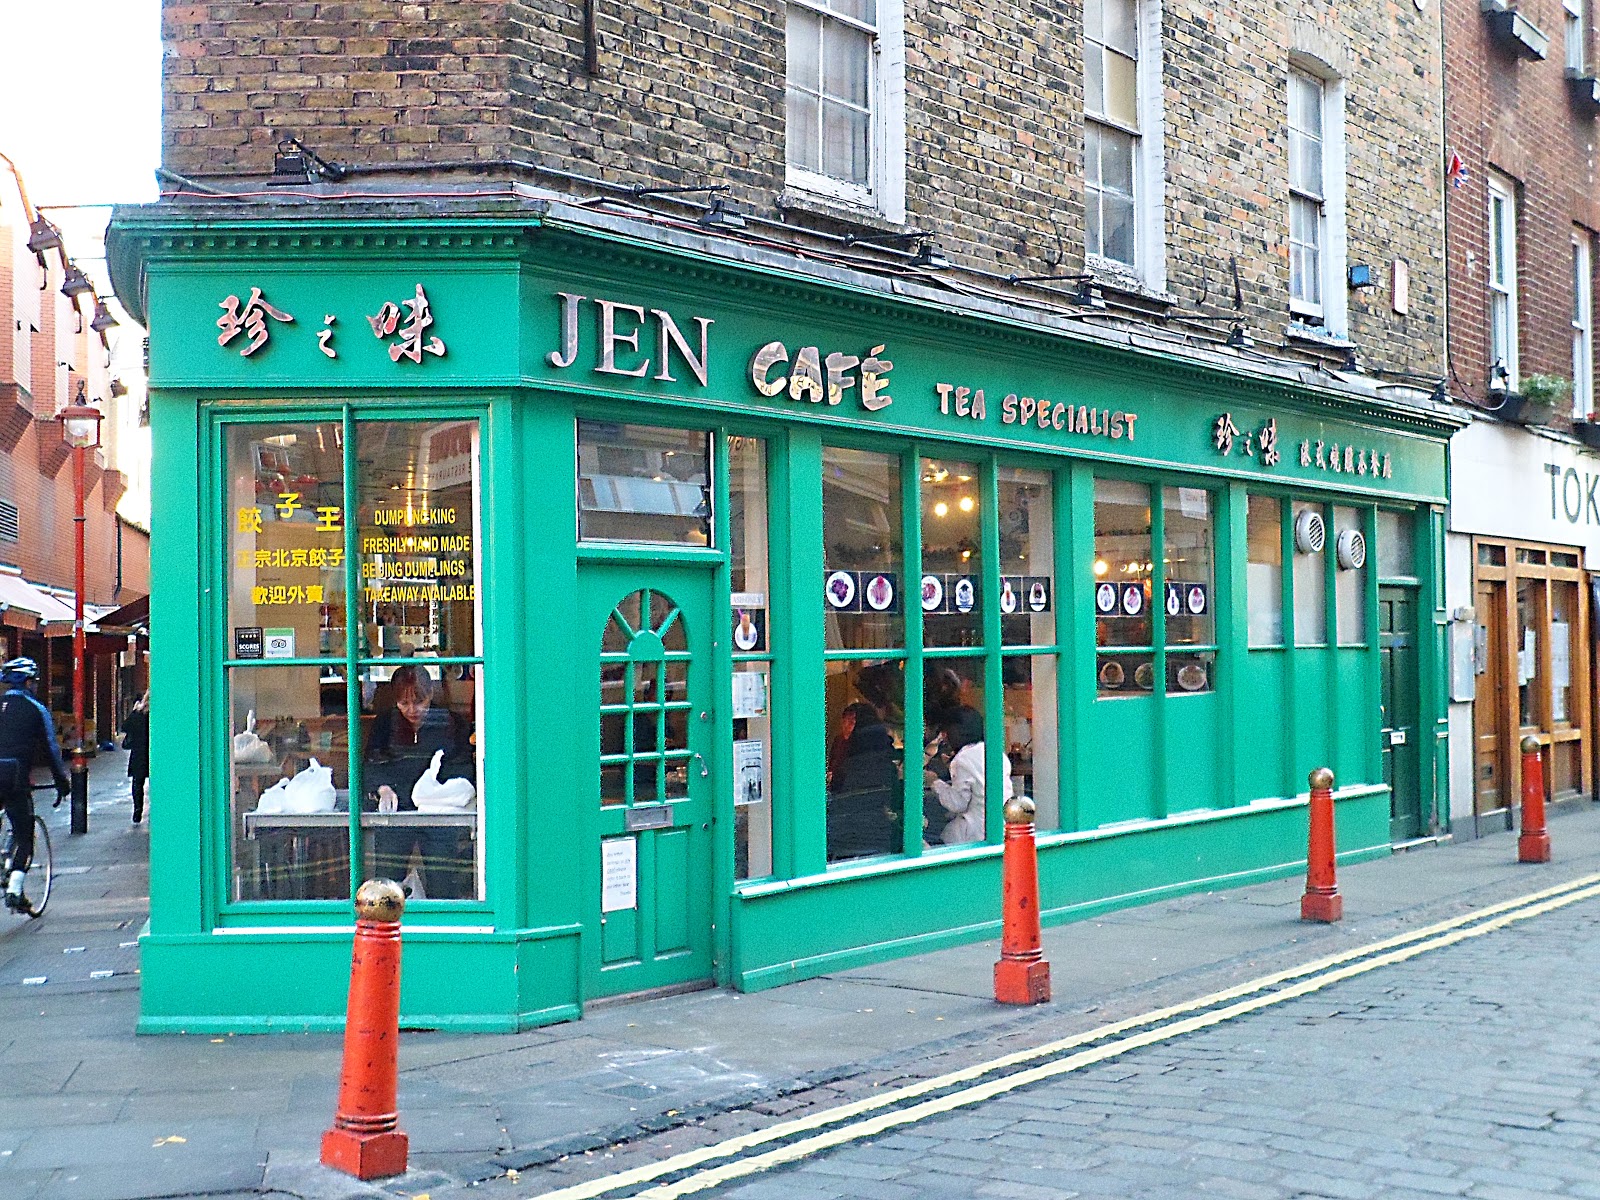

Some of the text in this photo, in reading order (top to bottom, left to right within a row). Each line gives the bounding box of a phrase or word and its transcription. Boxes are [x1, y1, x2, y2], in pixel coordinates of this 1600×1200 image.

[216, 283, 446, 364] 珍之味
[546, 291, 893, 411] JEN CAFÉ
[936, 382, 1138, 441] TEA SPECIALIST
[1543, 462, 1600, 527] TOK
[374, 508, 456, 525] DUMPLNG KING
[363, 535, 470, 553] FRESHLY HAND MADE
[404, 560, 465, 577] DUMPLINGS
[364, 584, 475, 603] TAKEAWAY AVAILABLE
